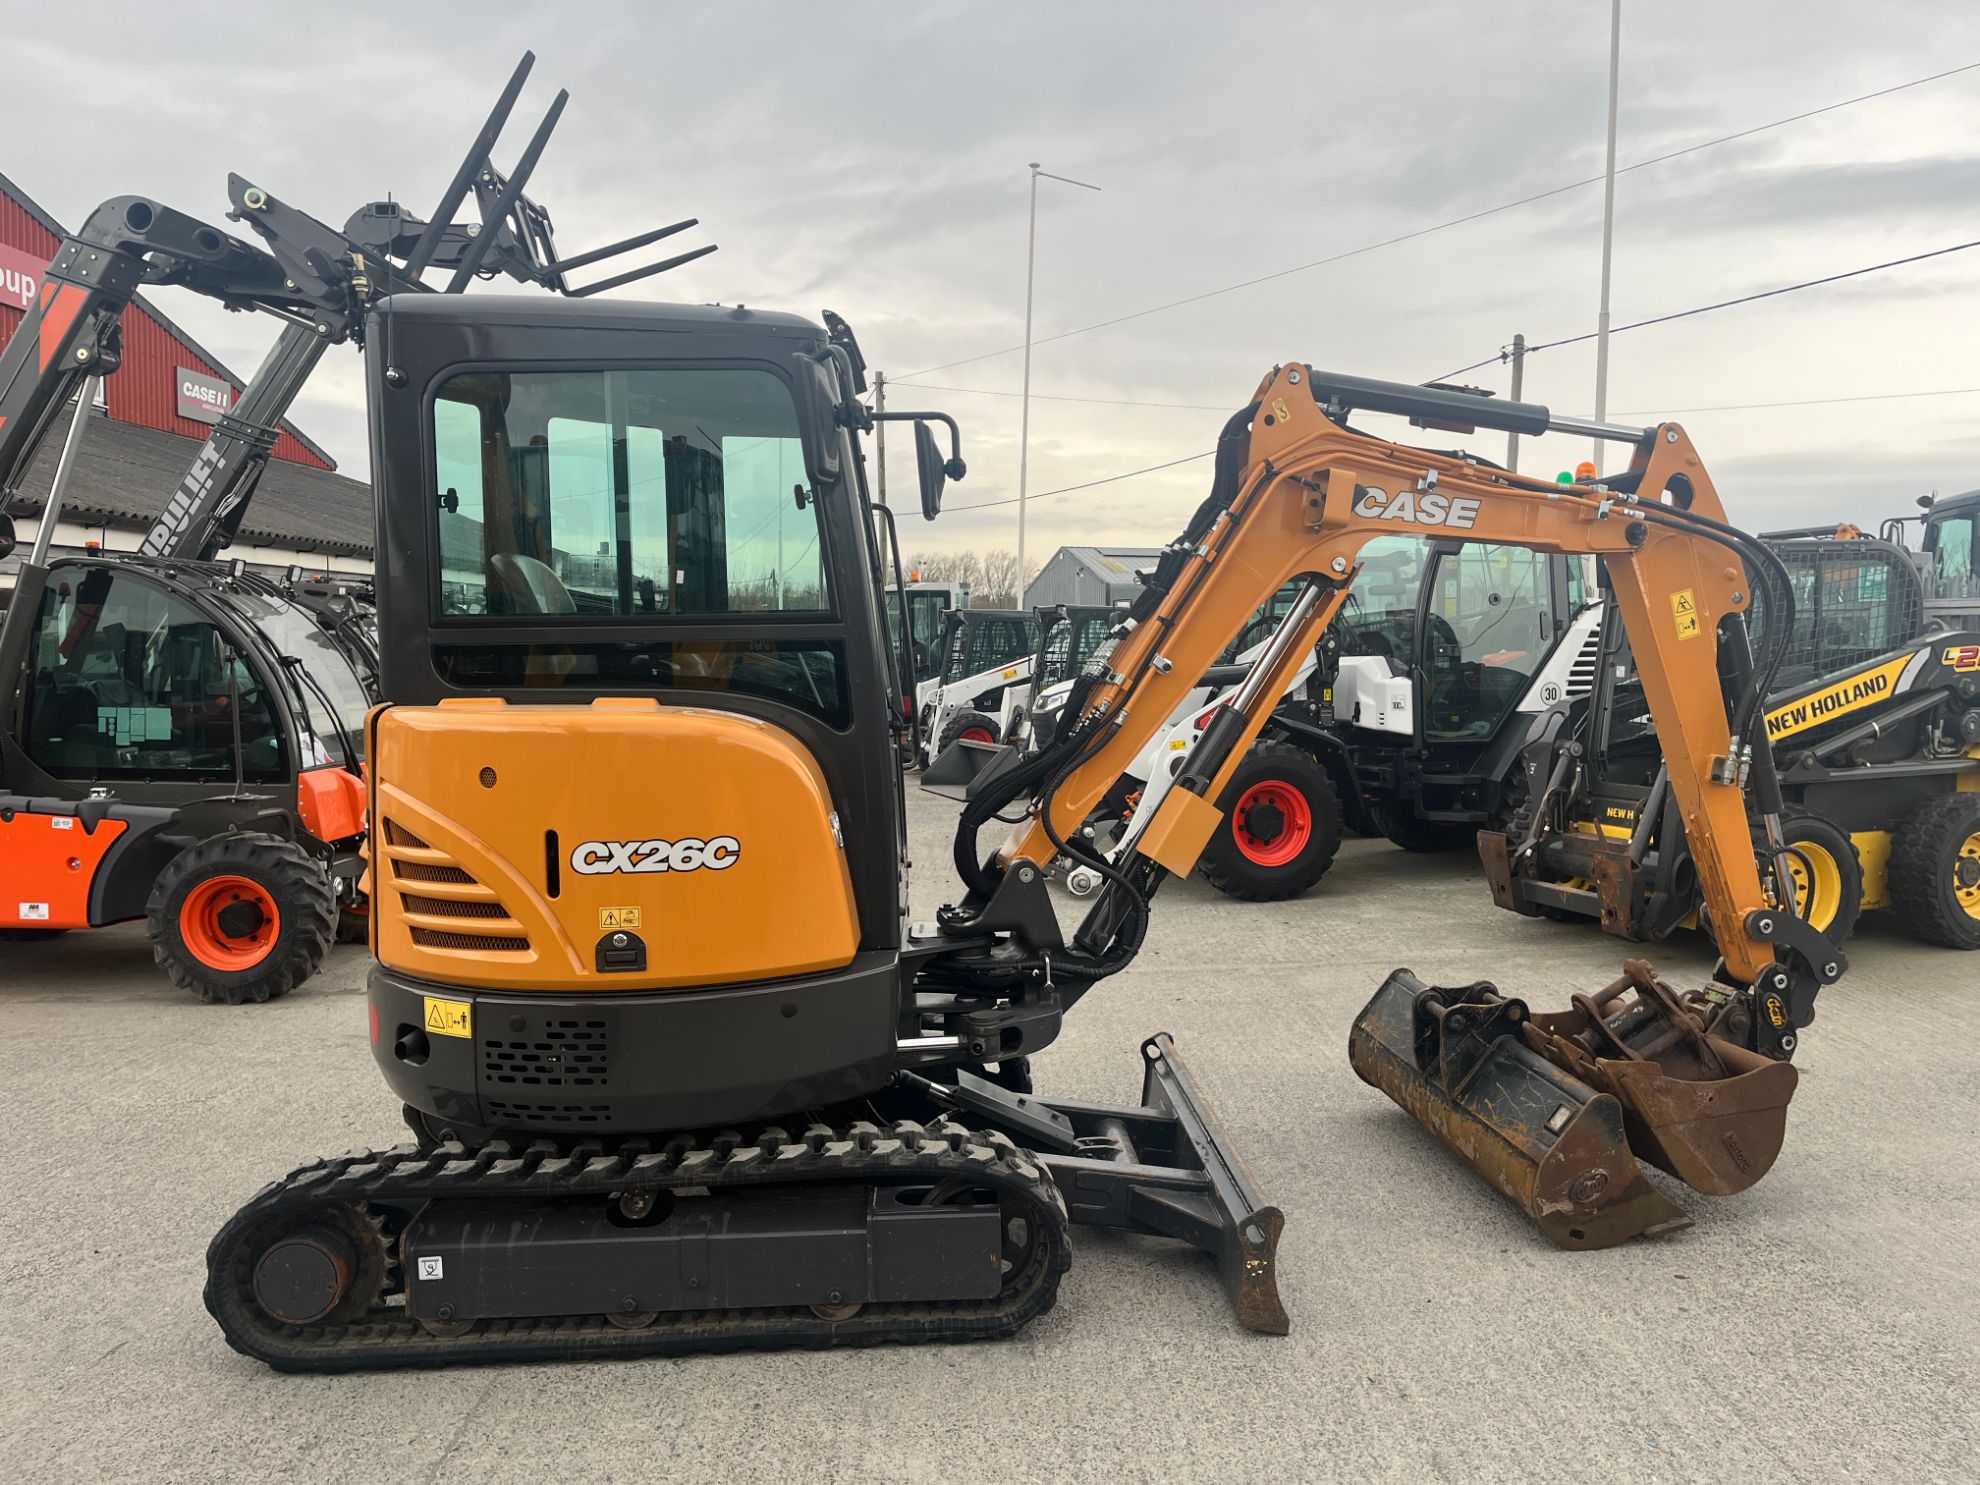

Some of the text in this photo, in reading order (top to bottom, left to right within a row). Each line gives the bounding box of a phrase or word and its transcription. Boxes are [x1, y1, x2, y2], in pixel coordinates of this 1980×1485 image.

[183, 382, 216, 404] CASE
[1352, 485, 1482, 529] CASE
[1942, 646, 1980, 671] L2
[1545, 687, 1557, 701] 30
[1766, 673, 1888, 736] NEW HOLLAND
[1606, 807, 1626, 819] NEW
[570, 835, 741, 875] CX26C
